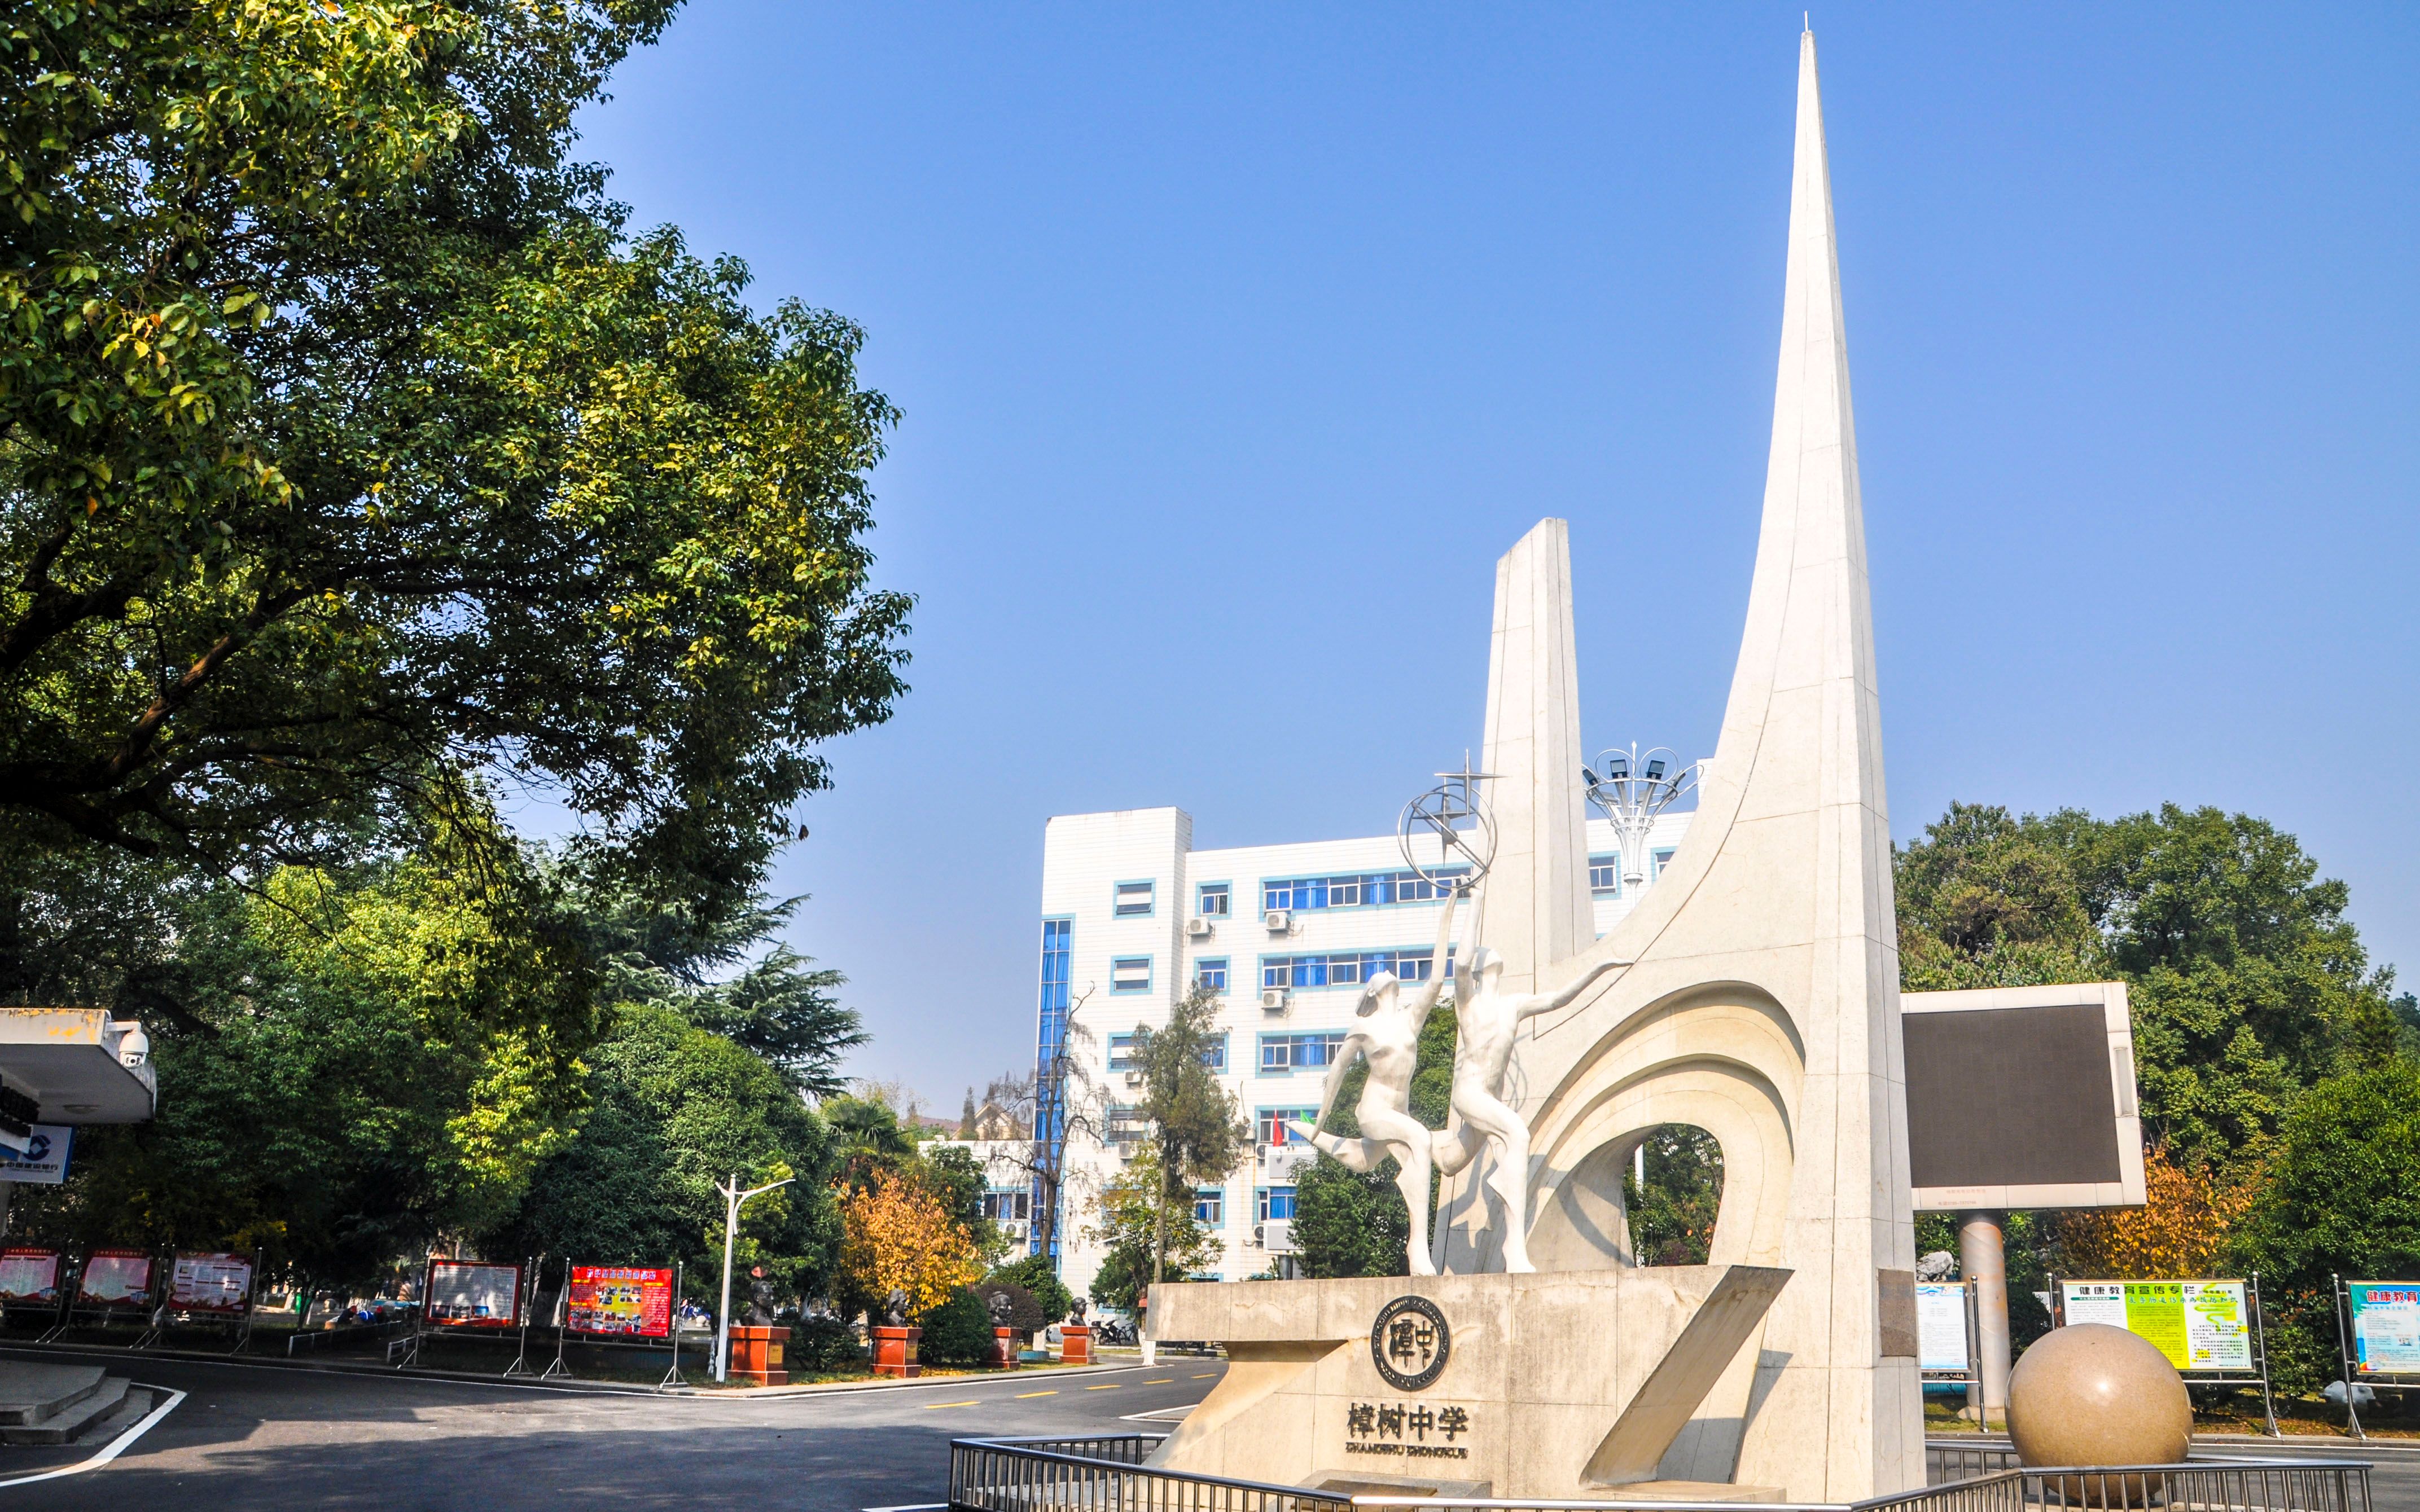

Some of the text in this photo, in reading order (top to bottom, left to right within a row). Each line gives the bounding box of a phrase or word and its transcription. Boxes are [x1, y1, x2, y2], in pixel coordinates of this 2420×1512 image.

[2079, 1286, 2195, 1295] 健康教育宣传专栏
[2366, 1290, 2420, 1303] 健康教育
[1347, 1403, 1468, 1442] 樟树中学
